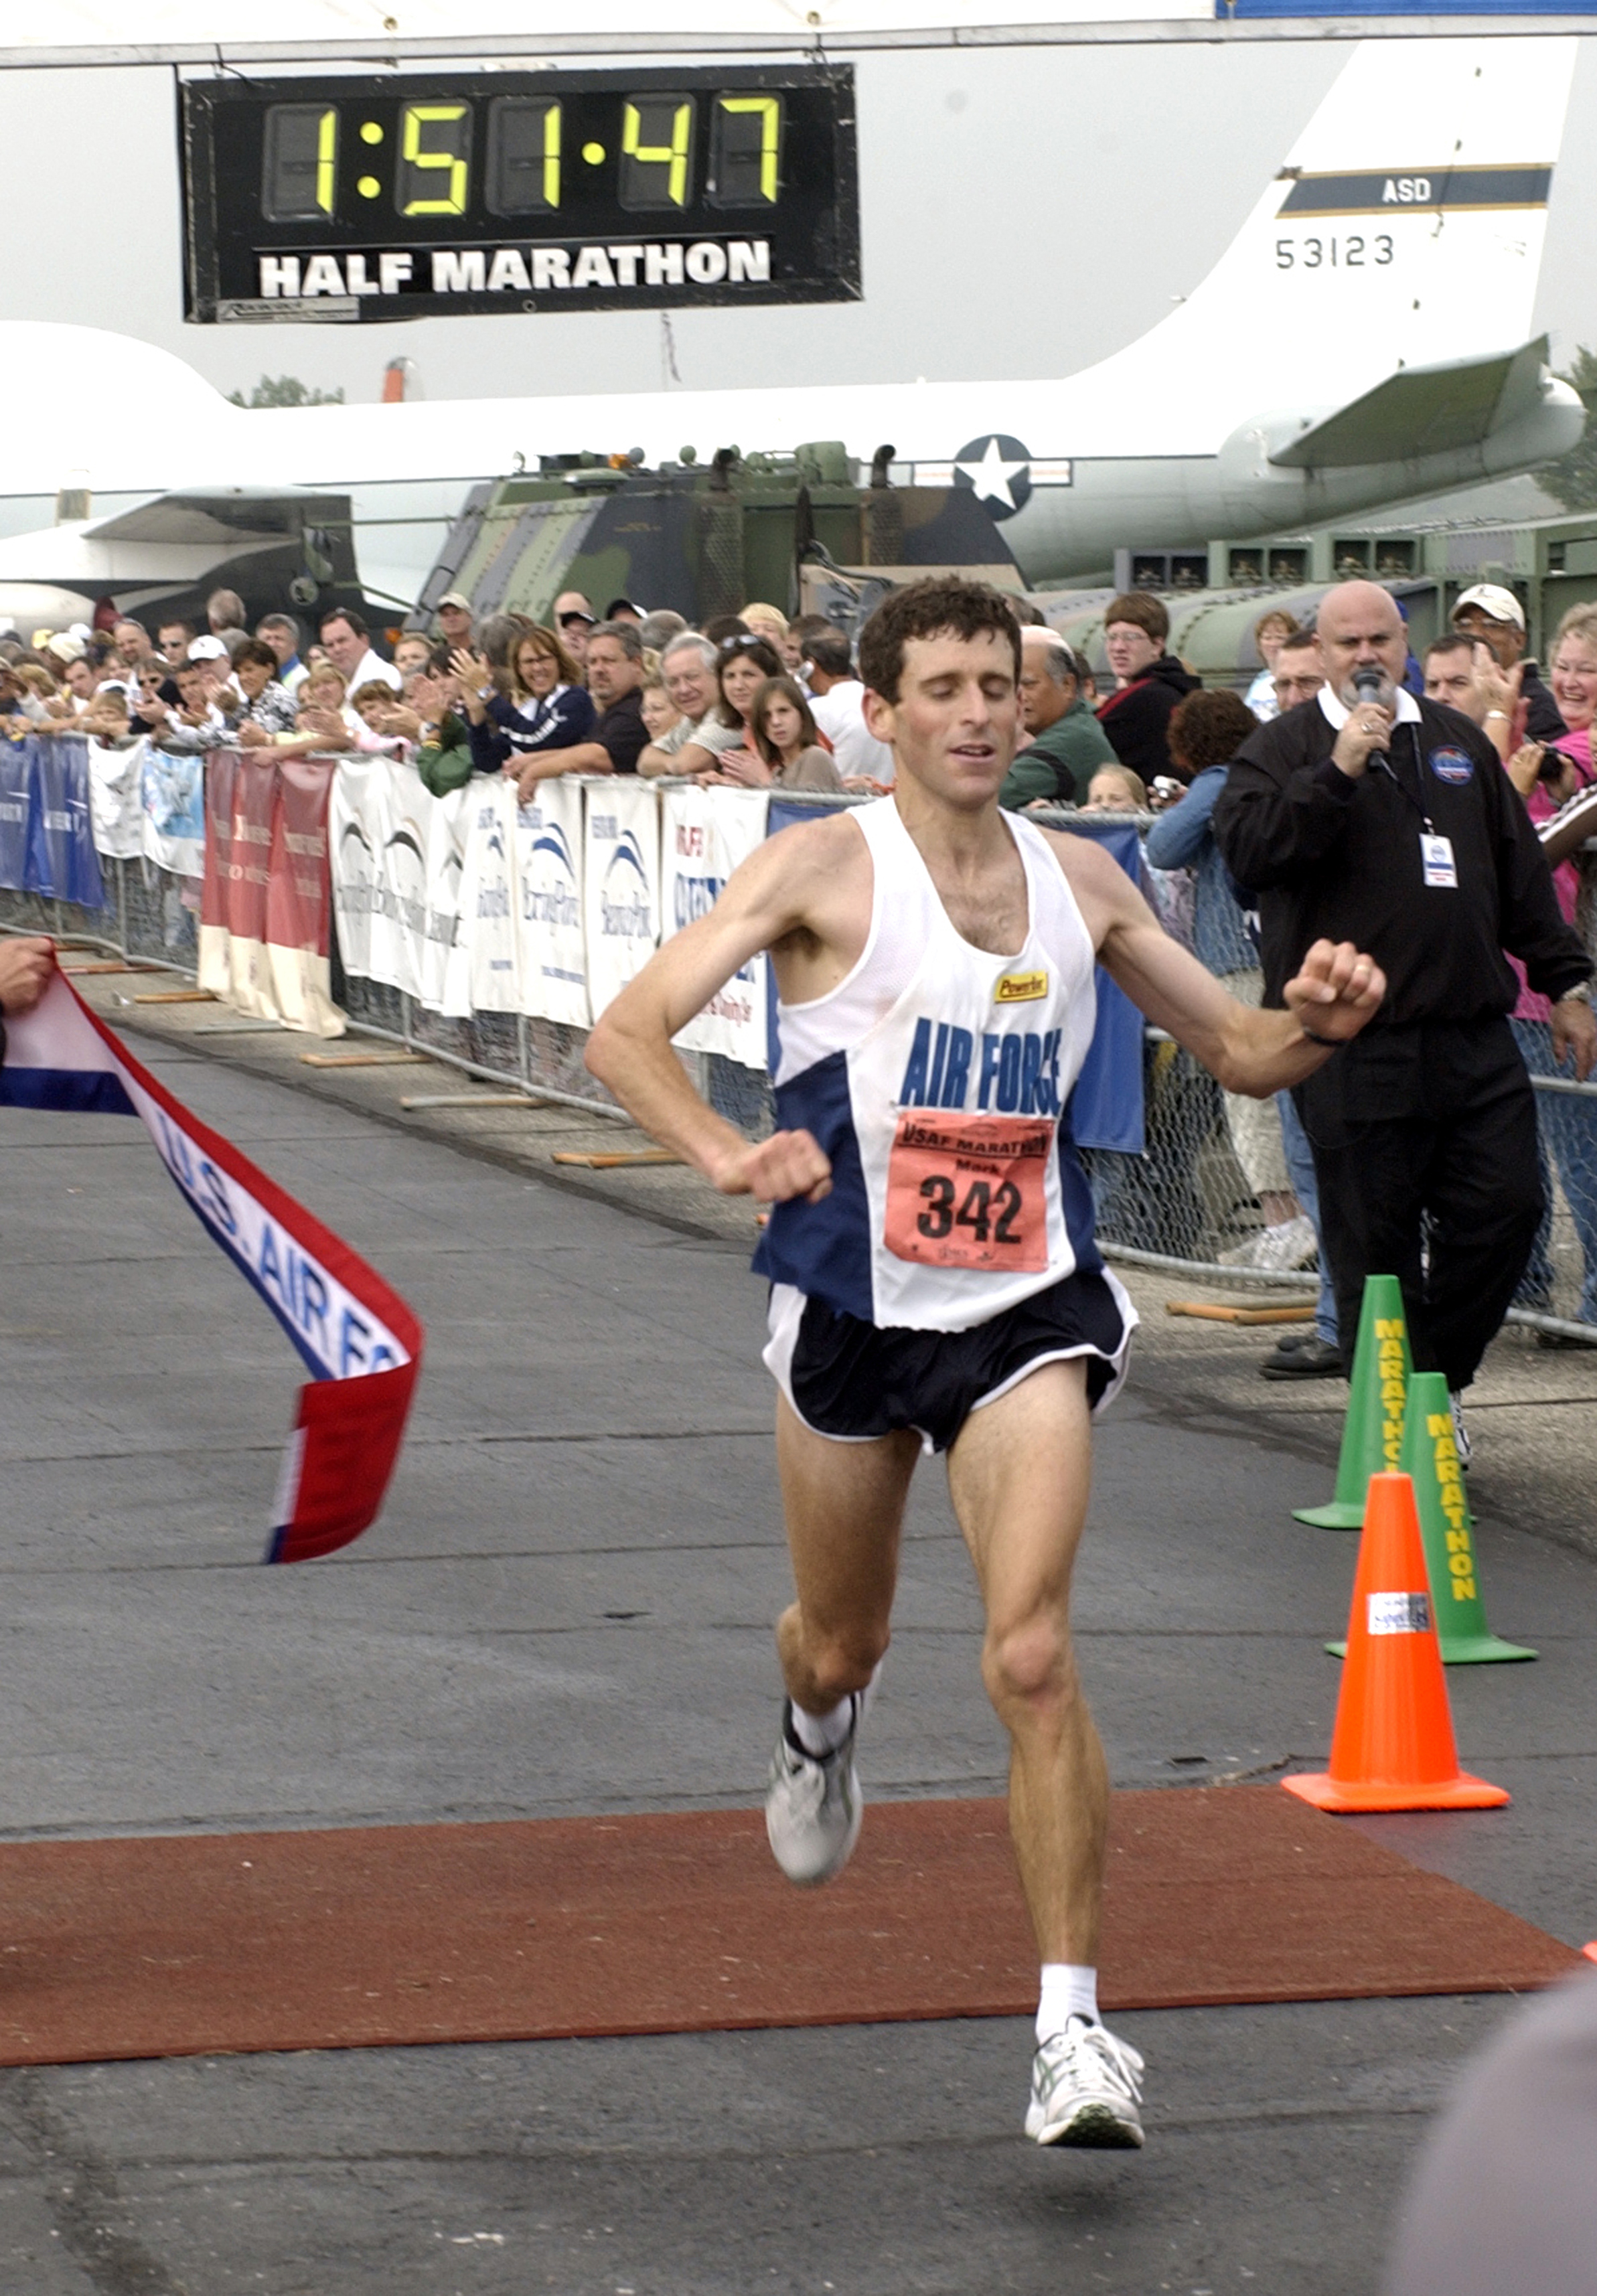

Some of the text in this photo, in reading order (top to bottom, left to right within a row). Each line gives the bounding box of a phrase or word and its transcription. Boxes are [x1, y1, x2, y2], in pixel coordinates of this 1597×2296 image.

[1382, 177, 1431, 202] ASD
[259, 240, 770, 298] HALF MARATHON
[1276, 234, 1394, 269] 53123
[899, 1016, 973, 1109] AIR
[903, 1122, 951, 1146] USAF
[956, 1158, 1000, 1174] Mark
[917, 1174, 1022, 1244] 342
[1426, 1413, 1476, 1601] MARATHON
